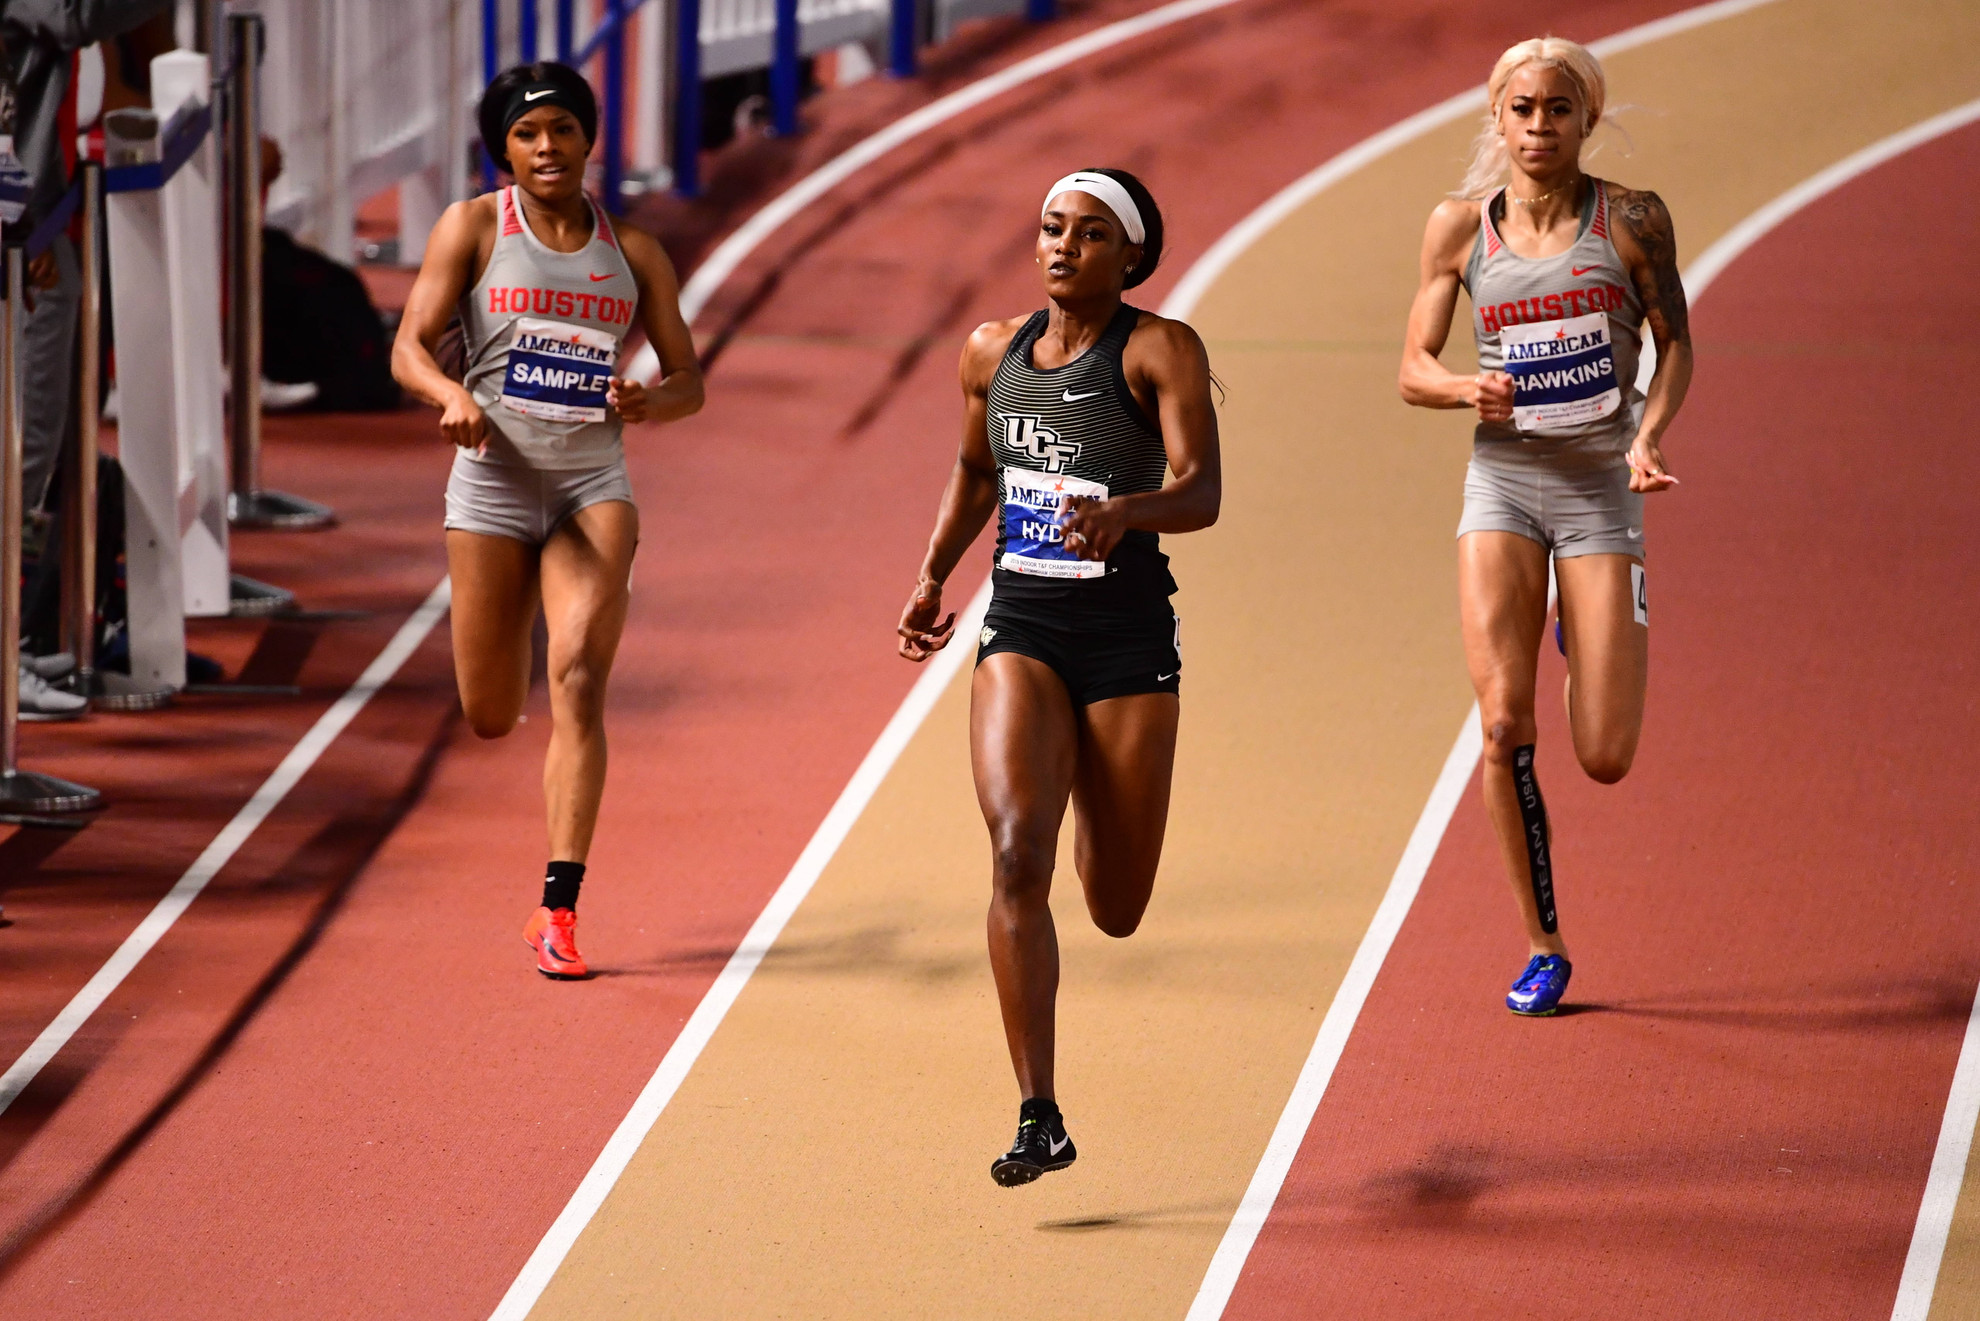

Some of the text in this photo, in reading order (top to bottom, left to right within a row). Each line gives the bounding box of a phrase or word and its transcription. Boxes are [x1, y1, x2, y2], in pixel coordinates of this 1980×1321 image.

[488, 287, 633, 325] HOUSTON
[1479, 285, 1626, 332] HOUSTON
[517, 334, 610, 362] AMERICAN
[1508, 329, 1604, 360] AMERICAN
[512, 362, 606, 392] SAMPLE
[1514, 357, 1613, 392] HAWKINS
[998, 413, 1082, 475] UCF
[1011, 486, 1100, 509] AMERI
[1022, 520, 1065, 543] HYD
[1521, 771, 1536, 808] USA
[1532, 822, 1551, 905] TEAM
